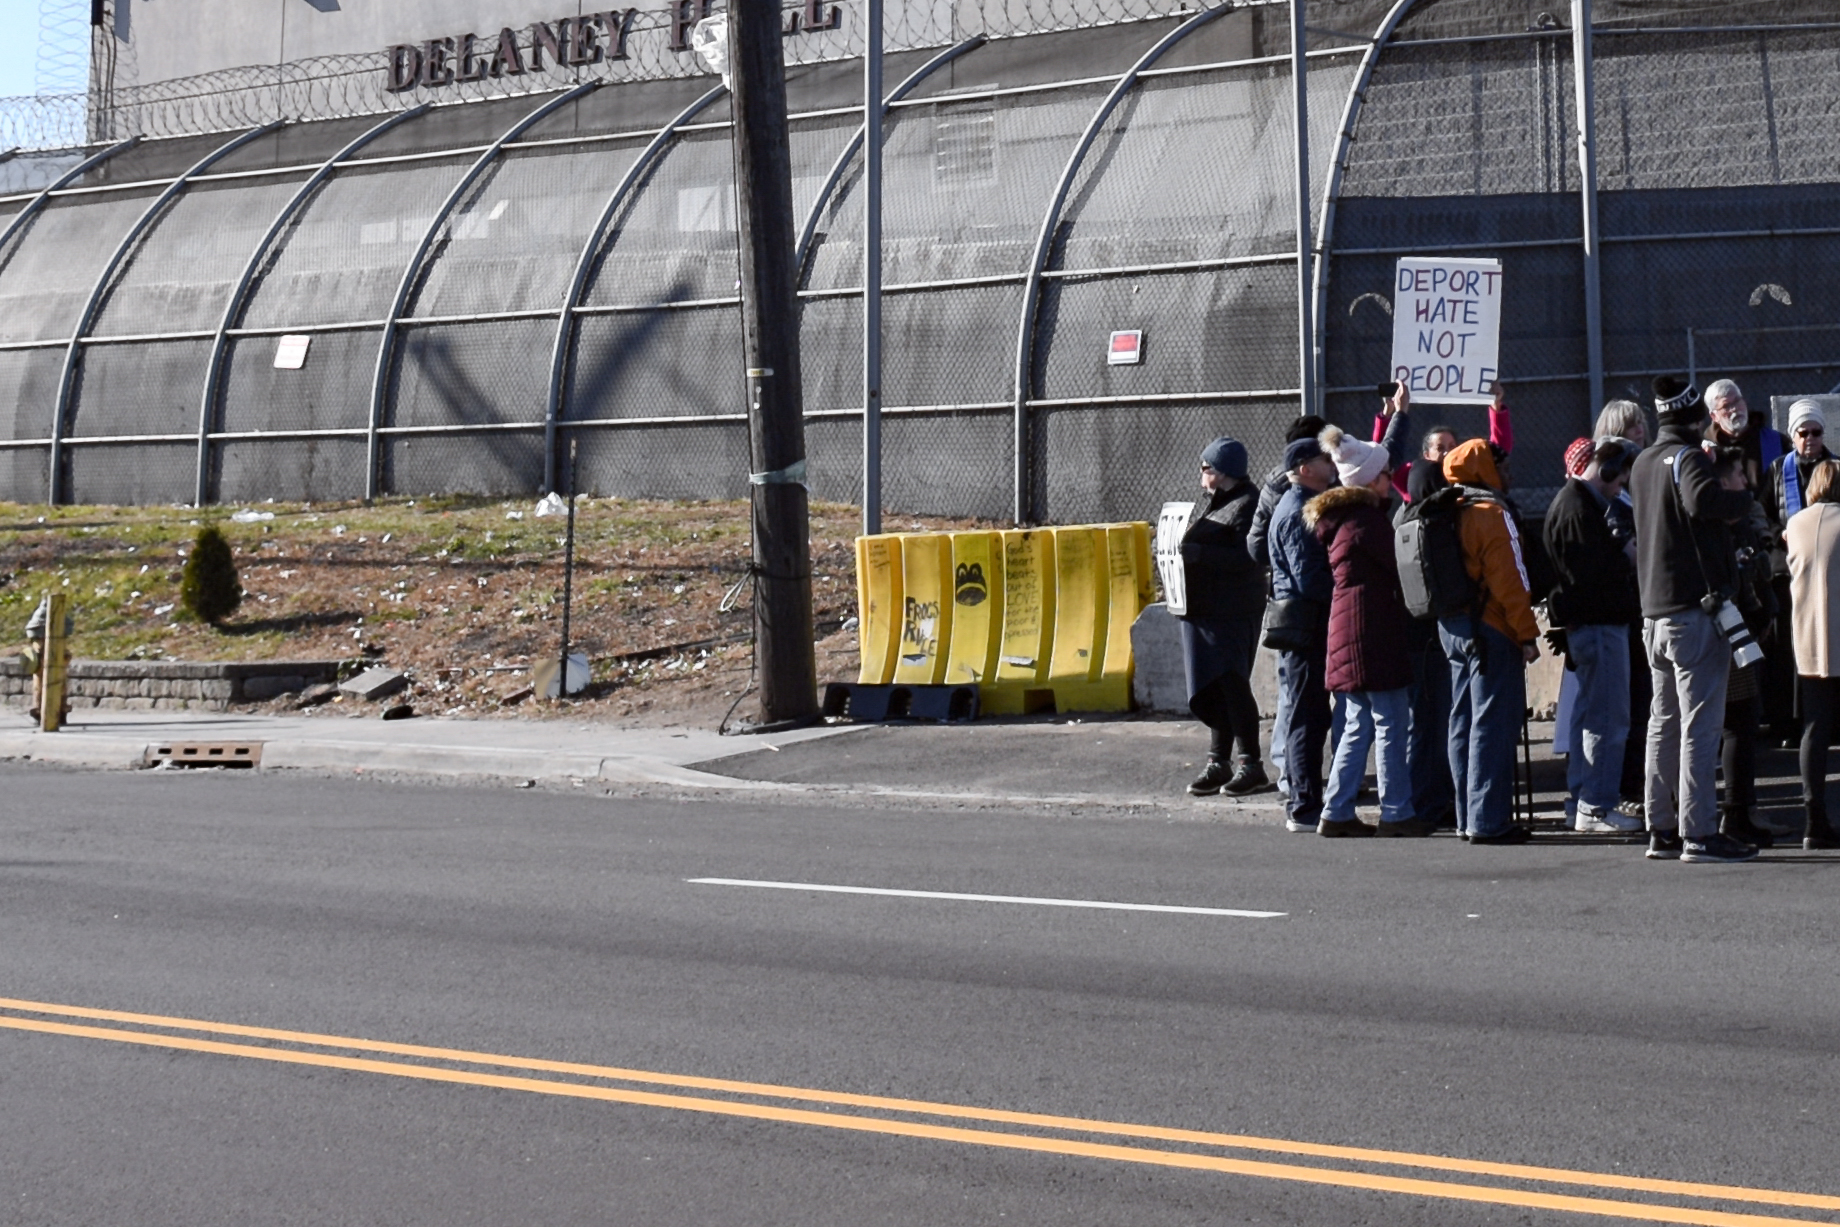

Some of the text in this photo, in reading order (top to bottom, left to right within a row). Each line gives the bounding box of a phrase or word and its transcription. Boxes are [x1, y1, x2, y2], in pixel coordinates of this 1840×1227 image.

[386, 7, 638, 93] DELANEY
[1399, 268, 1502, 297] DEPORT
[1415, 297, 1479, 324] HATE
[1418, 329, 1477, 359] NOT
[1395, 364, 1497, 395] PEOPLE
[1672, 391, 1694, 410] NYC
[905, 596, 940, 621] FROGS
[1006, 589, 1039, 606] LOVE
